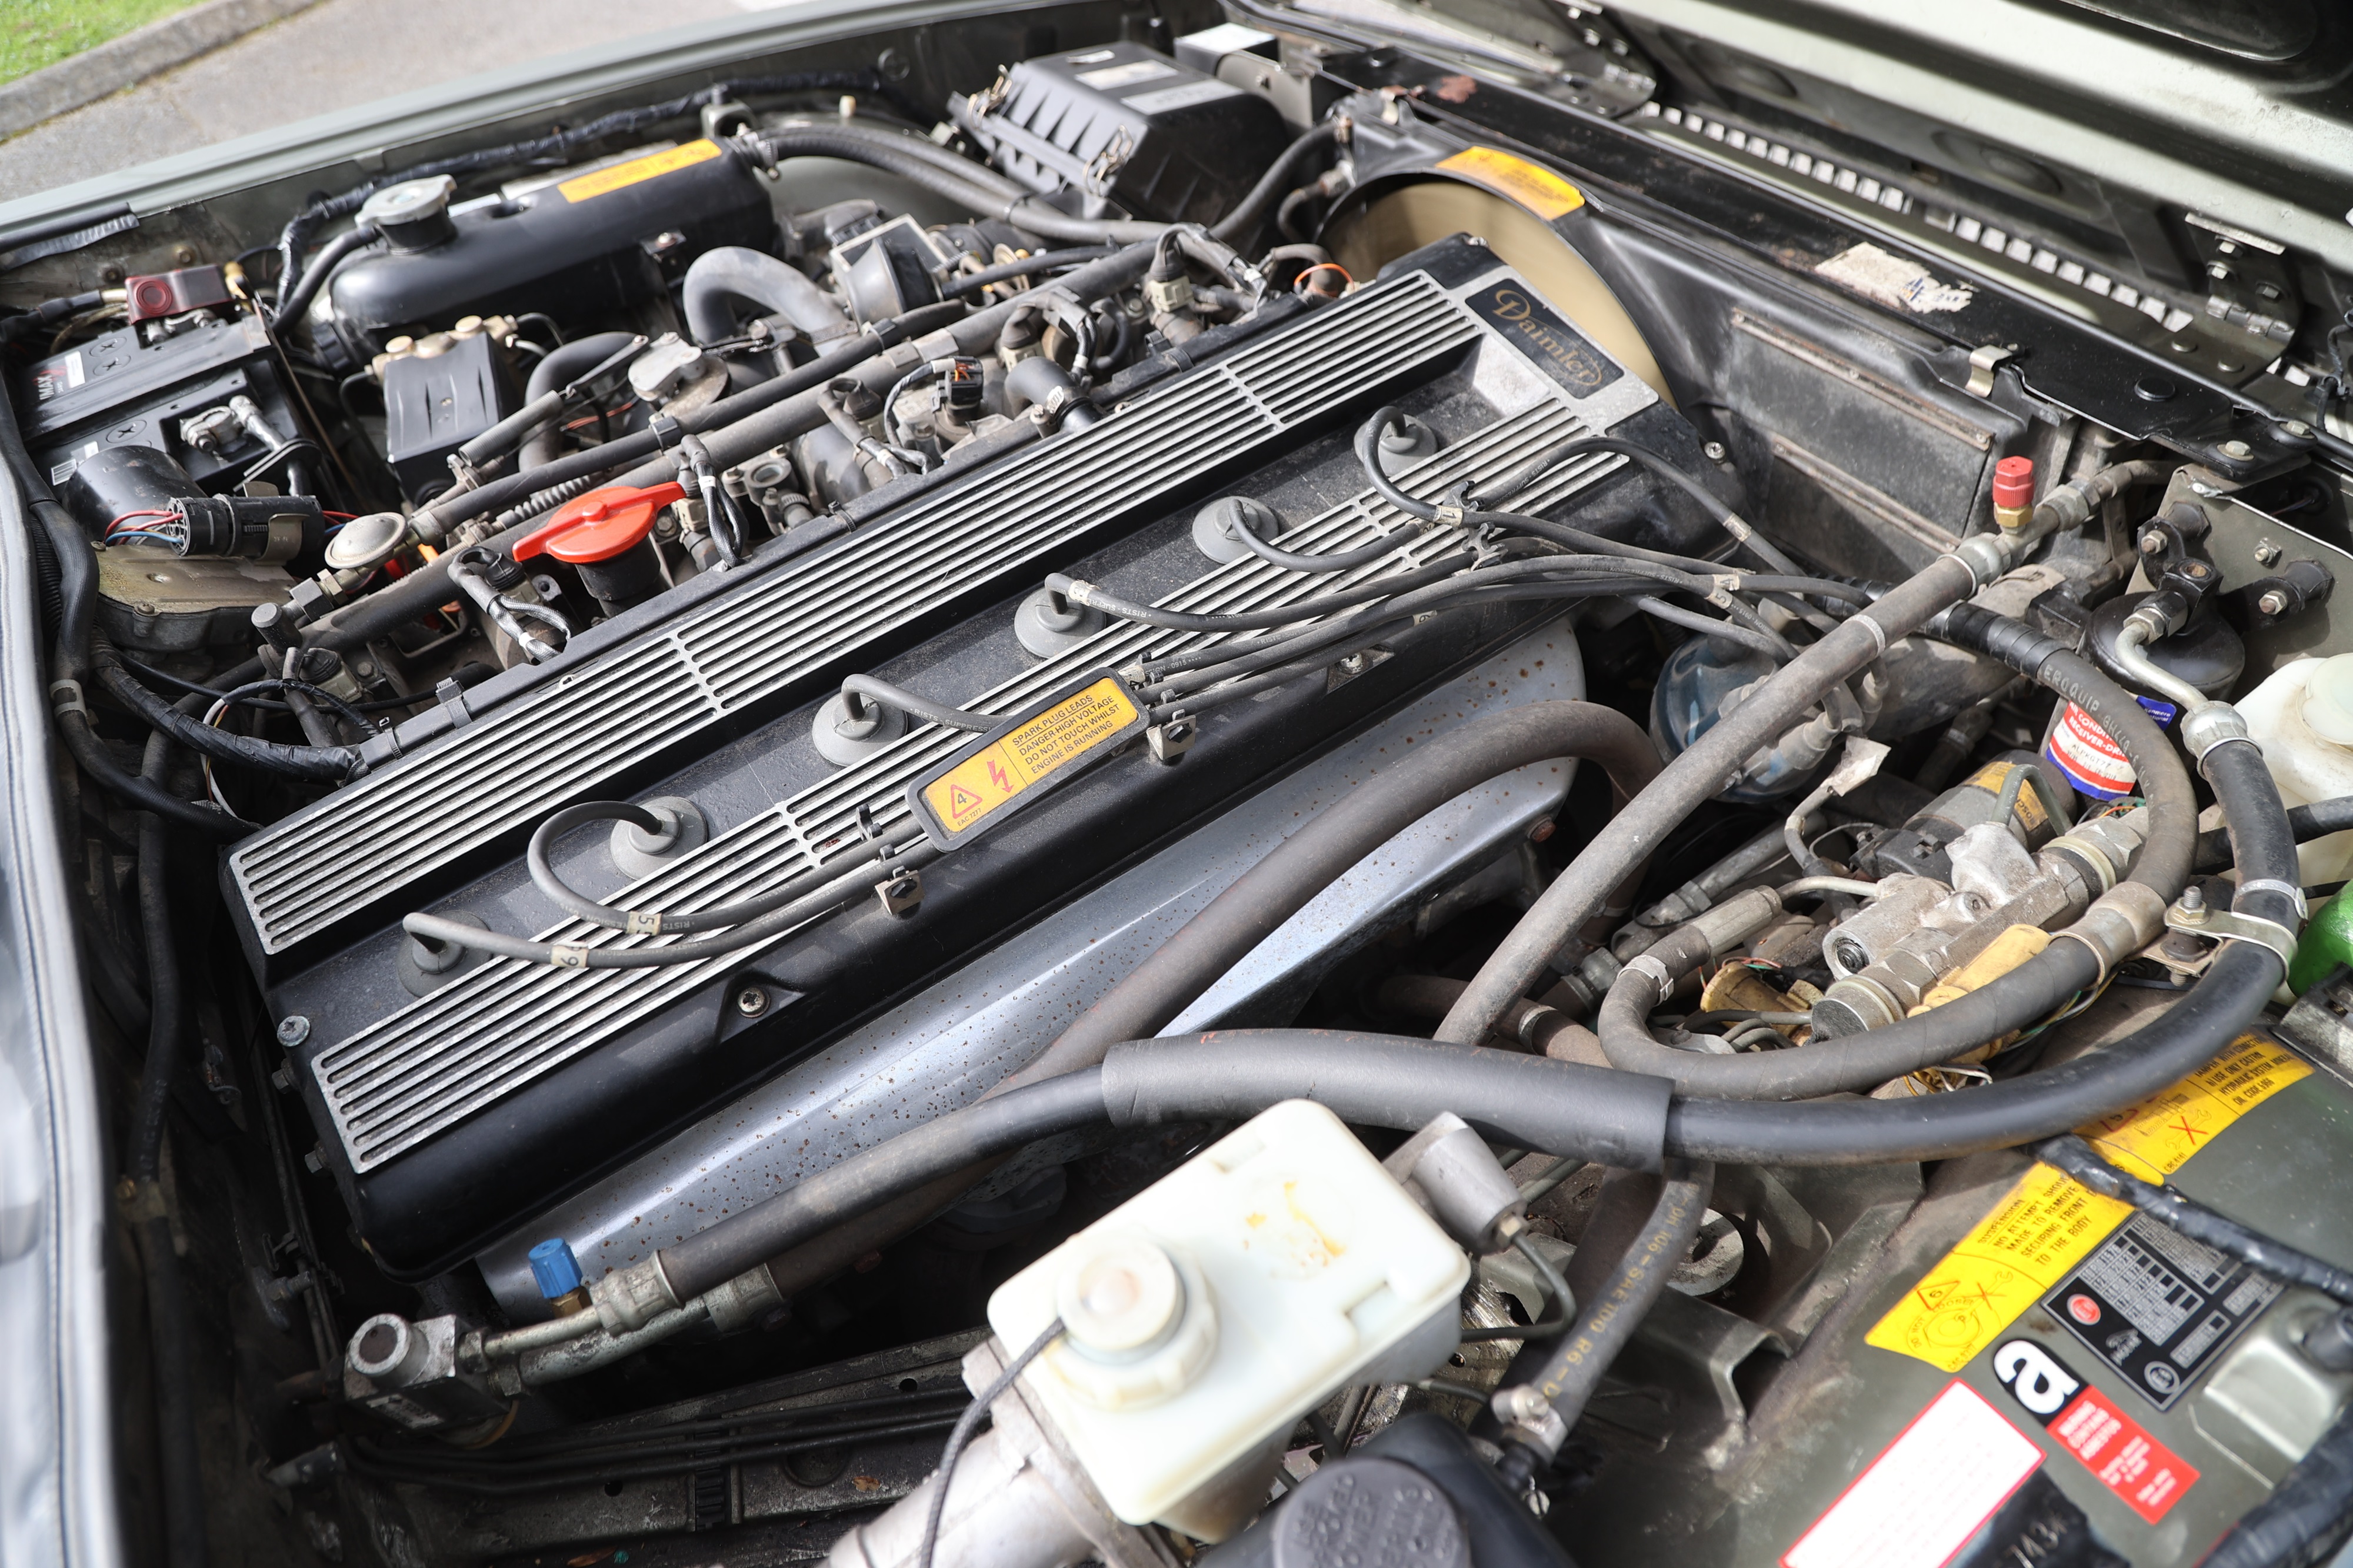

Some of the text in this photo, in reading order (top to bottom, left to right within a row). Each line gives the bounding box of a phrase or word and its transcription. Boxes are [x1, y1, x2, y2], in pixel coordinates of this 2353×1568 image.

[1492, 289, 1602, 386] Daimler
[1530, 460, 1549, 476] RISTS
[1086, 598, 1146, 619] RISTS SUPPRE
[1715, 593, 1727, 604] 5
[1171, 659, 1187, 672] 0915
[2040, 665, 2099, 712] EROQUIP
[915, 709, 991, 732] RISTS SUPPRESSI
[1012, 695, 1093, 746] SPARK PLUG LEADS
[1077, 695, 1114, 725] VOLTAGE
[2069, 701, 2078, 716] AIR
[1025, 704, 1121, 765] DO NOT TOUCH WHILST
[1031, 720, 1114, 774] ENGINE IS RUNNING
[957, 793, 967, 805] 4
[957, 808, 982, 827] EAC 7277
[662, 921, 690, 930] RISTS
[2214, 1070, 2228, 1082] USE
[2225, 1063, 2244, 1075] ONLY
[2219, 1073, 2254, 1096] HYDRAULIC
[2250, 1061, 2275, 1077] SYSTEM
[2232, 1096, 2247, 1106] OIL
[2242, 1087, 2263, 1099] CODE
[1978, 1199, 2025, 1245] SUSPENSION
[1994, 1236, 2009, 1248] NO
[2008, 1200, 2044, 1235] ATTEMPT
[2043, 1176, 2072, 1199] SHOUL
[2007, 1229, 2034, 1252] MADE
[2033, 1215, 2047, 1227] TO
[2044, 1186, 2079, 1216] REMOVE
[1648, 1230, 1672, 1254] 106
[2021, 1197, 2088, 1258] SECURING FRONT
[2035, 1215, 2092, 1266] TO THE BODY
[1612, 1267, 1645, 1303] SAE
[1589, 1302, 1619, 1334] 100
[1567, 1337, 1594, 1366] R6
